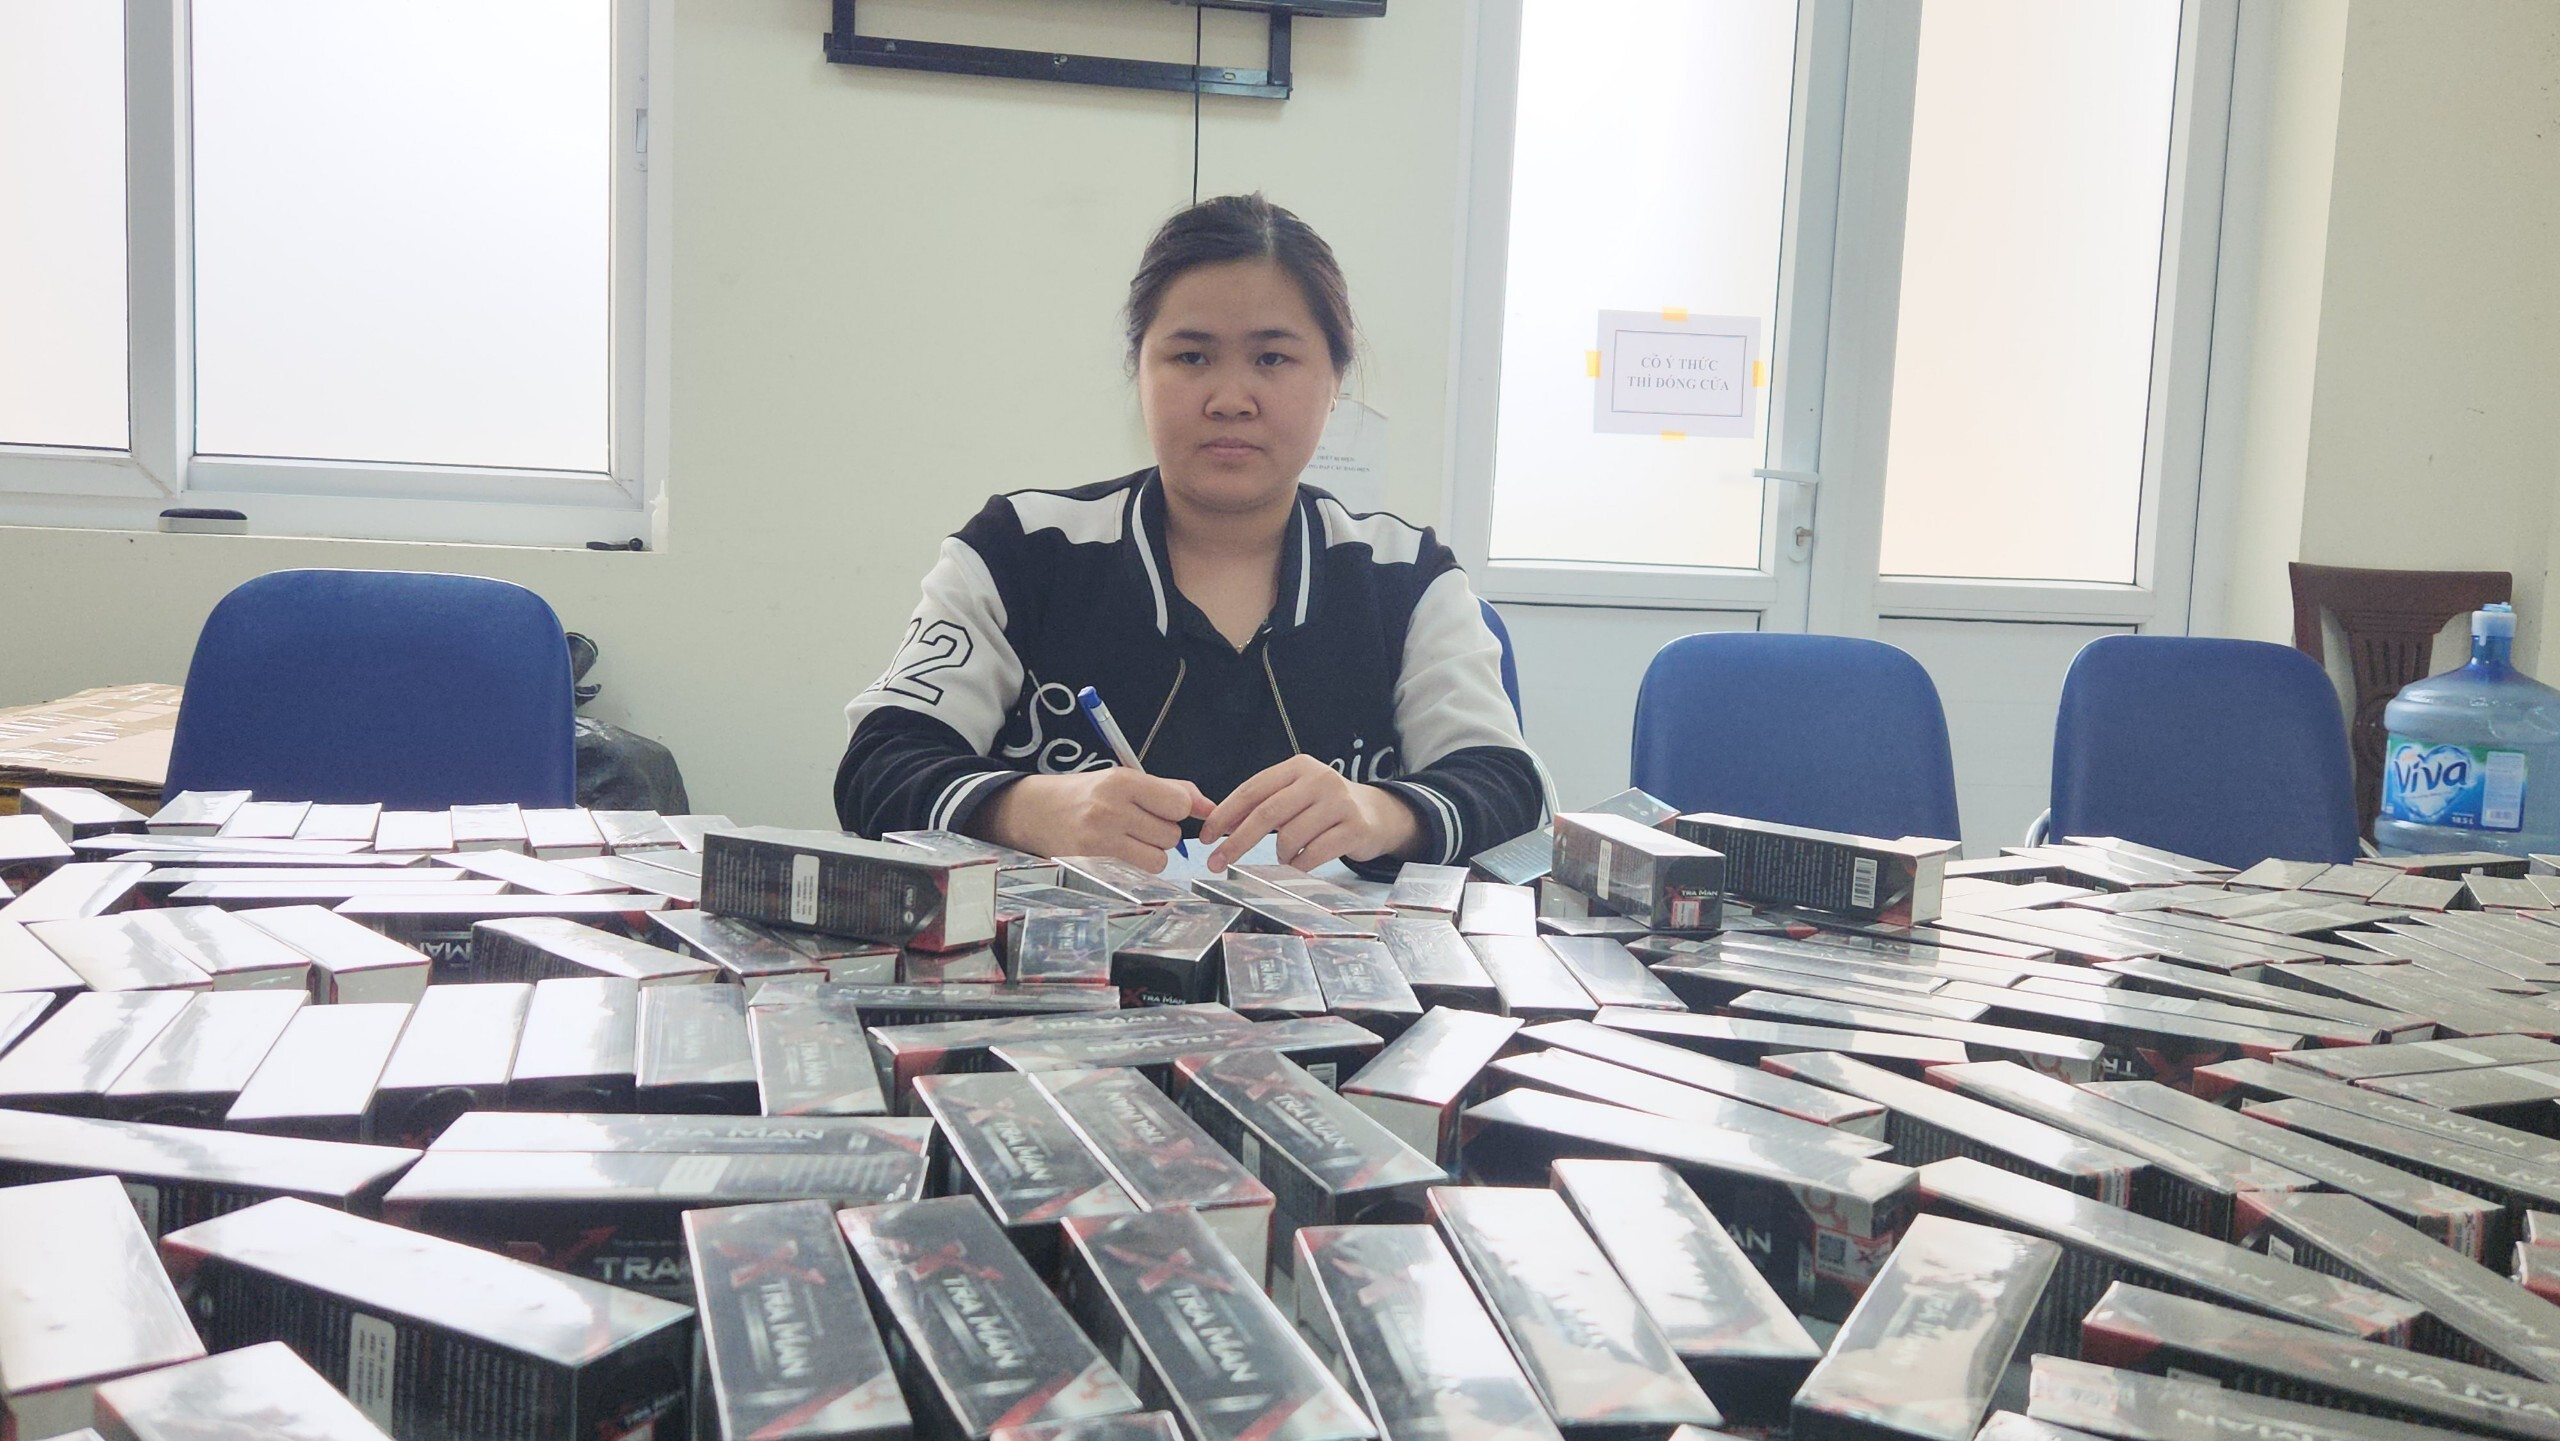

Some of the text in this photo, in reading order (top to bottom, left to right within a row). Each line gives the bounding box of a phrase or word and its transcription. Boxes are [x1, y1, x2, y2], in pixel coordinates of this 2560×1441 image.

[1666, 355, 1675, 369] Ý
[1678, 356, 1719, 371] THỨC
[1655, 375, 1696, 390] ĐÓNG
[1726, 1223, 1771, 1254] AN
